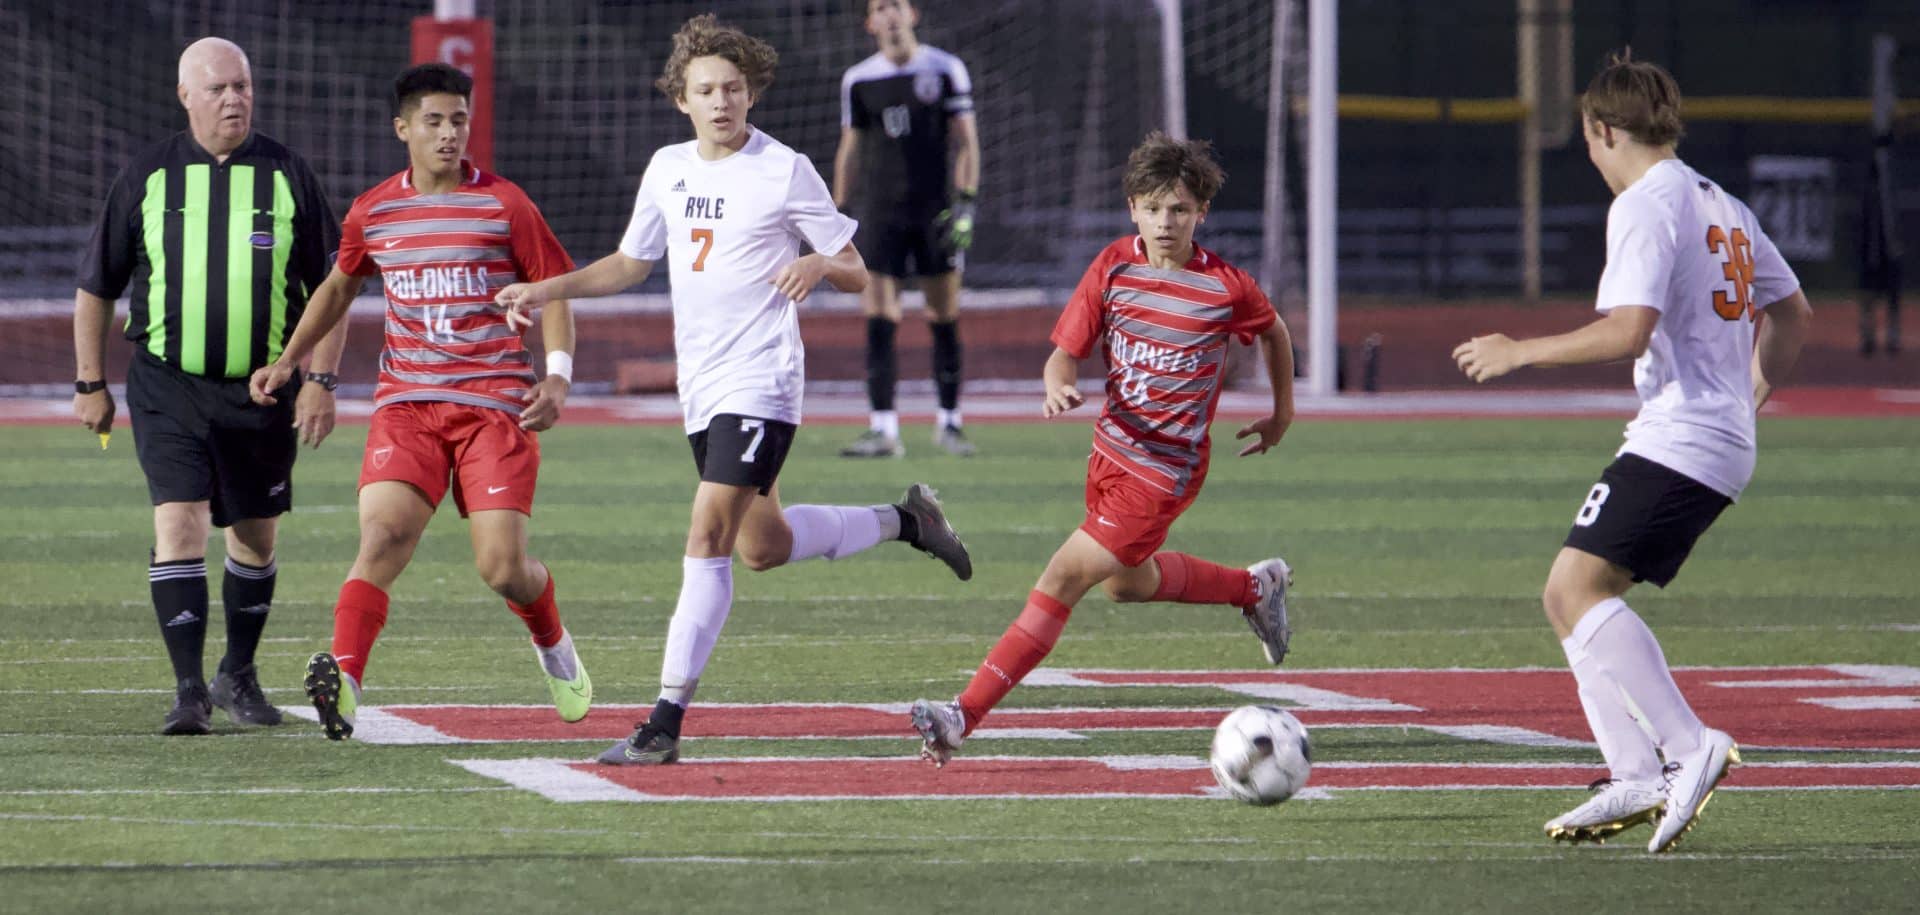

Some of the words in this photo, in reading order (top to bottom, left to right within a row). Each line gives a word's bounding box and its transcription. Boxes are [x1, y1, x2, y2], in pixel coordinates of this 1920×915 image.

[684, 196, 725, 219] RYLE
[691, 228, 714, 272] 7
[1706, 225, 1756, 322] 38
[423, 304, 455, 342] 14
[741, 419, 765, 462] 7
[1576, 482, 1611, 527] 8
